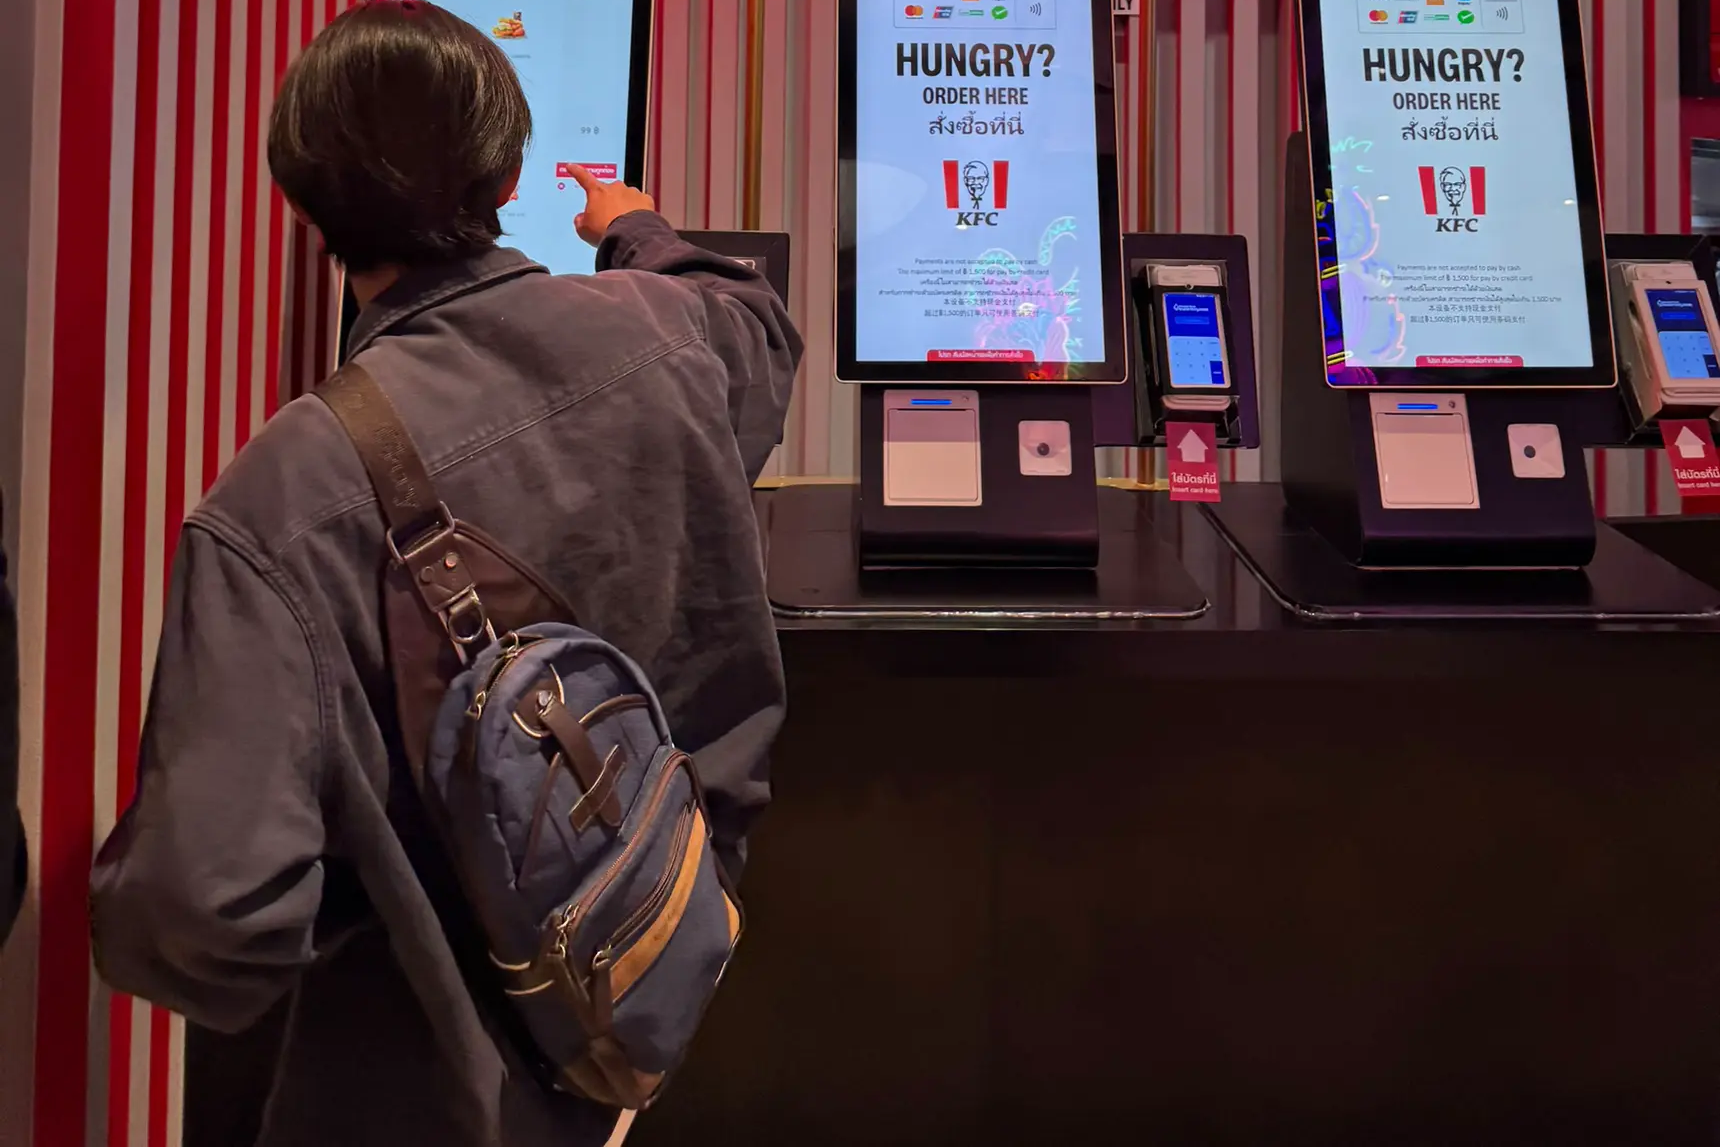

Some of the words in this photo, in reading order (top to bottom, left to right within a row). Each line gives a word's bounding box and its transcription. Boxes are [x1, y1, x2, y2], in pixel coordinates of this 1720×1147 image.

[896, 42, 1056, 78] HUNGRY?
[1363, 47, 1525, 83] HUNGRY?
[923, 86, 980, 104] ORDER
[985, 87, 1029, 105] HERE
[1393, 92, 1452, 110] ORDER
[1457, 92, 1501, 110] HERE
[580, 126, 592, 135] 99
[929, 111, 1025, 136] สั่งซื้อที่นี่
[1401, 116, 1499, 141] สั่งซื้อที่นี่
[956, 211, 999, 226] KFC
[1436, 217, 1479, 232] KFC
[1171, 471, 1217, 484] ใส่บัตรที่นี่
